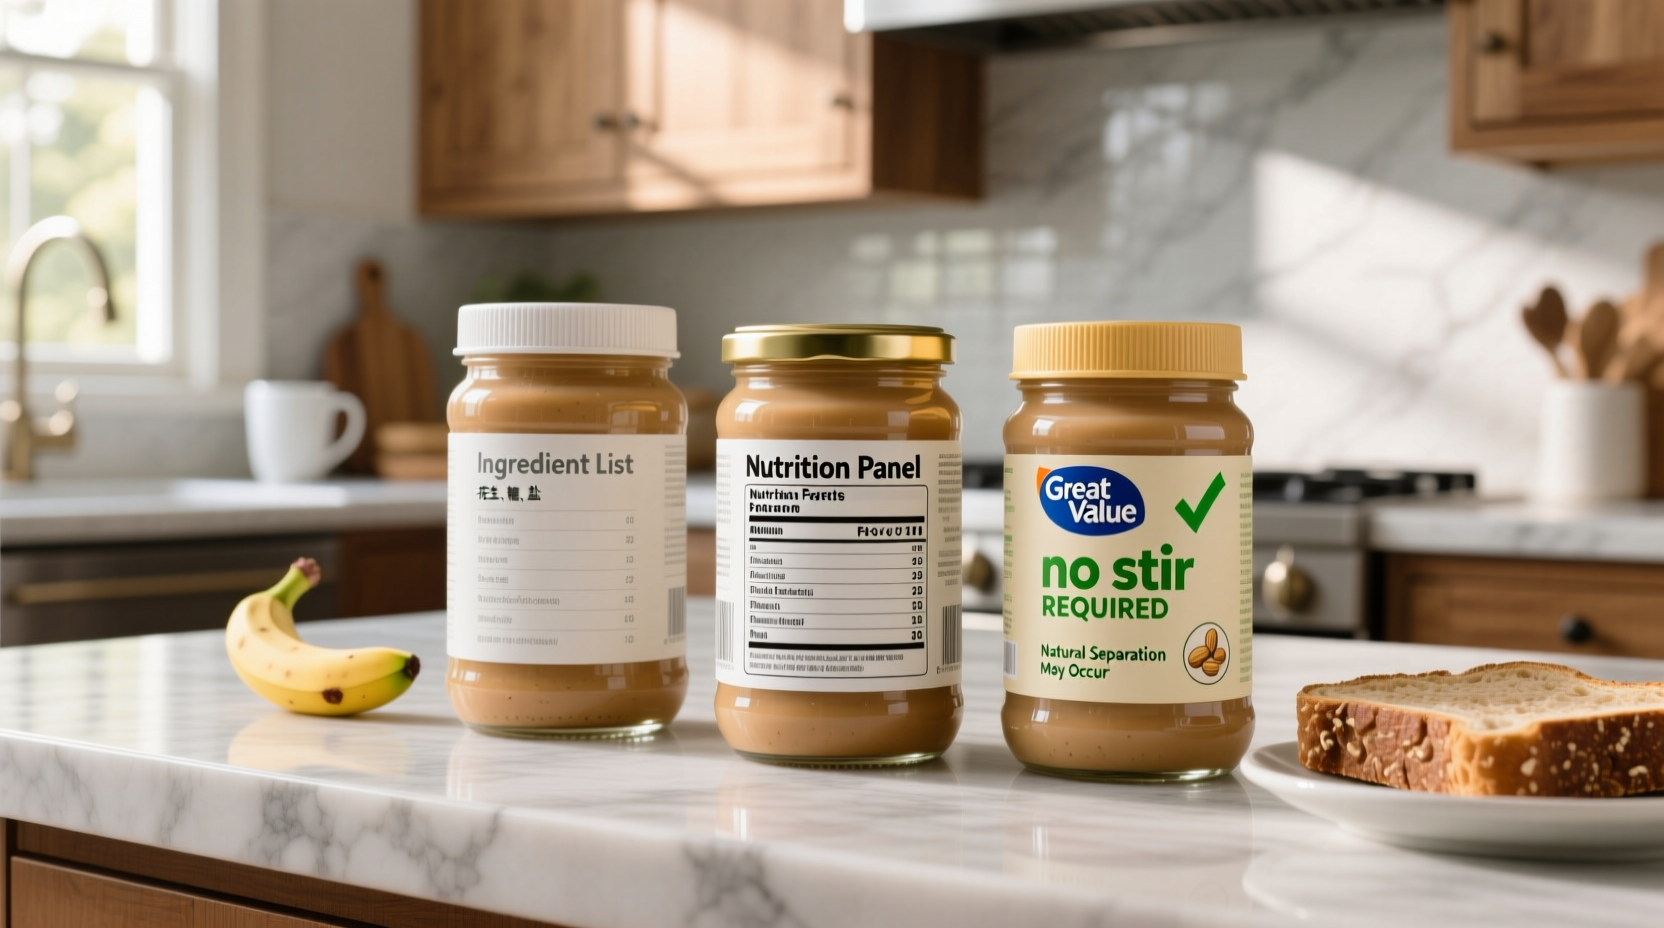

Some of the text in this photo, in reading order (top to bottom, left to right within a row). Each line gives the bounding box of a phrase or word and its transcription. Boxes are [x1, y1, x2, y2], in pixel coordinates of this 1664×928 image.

[478, 452, 634, 480] Ingredient List
[746, 454, 921, 480] Nutrition Panel
[1045, 475, 1111, 500] Great
[1068, 499, 1137, 524] Value
[1042, 543, 1195, 591] no stir
[1042, 595, 1169, 622] REQUIRED
[1041, 644, 1166, 664] Natural Separation
[1041, 662, 1110, 680] May Occur
